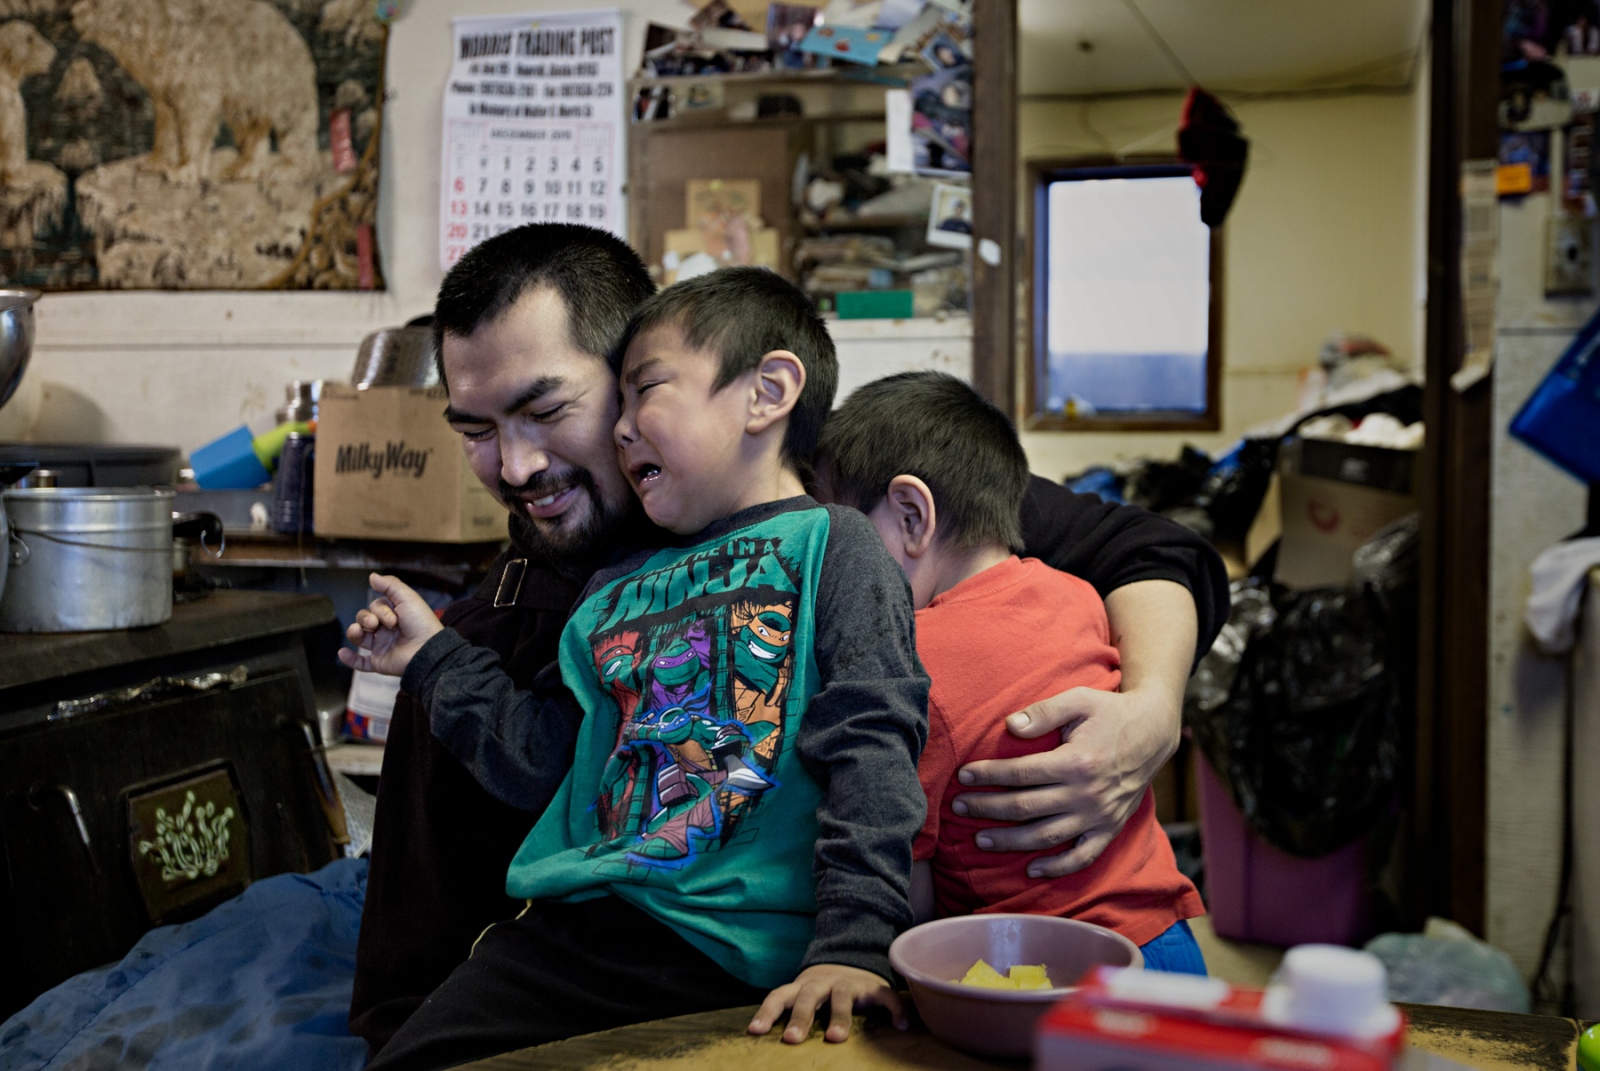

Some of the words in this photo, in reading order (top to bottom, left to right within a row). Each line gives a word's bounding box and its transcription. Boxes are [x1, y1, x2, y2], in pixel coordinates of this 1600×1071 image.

[516, 29, 577, 56] TRADING
[580, 28, 614, 55] POST
[503, 155, 512, 171] 1
[525, 155, 536, 172] 2
[549, 156, 559, 172] 3
[571, 156, 581, 172] 4
[594, 156, 604, 173] 5
[453, 176, 465, 193] 6
[478, 177, 488, 193] 7
[501, 178, 511, 194] 8
[524, 179, 535, 194] 9
[545, 180, 562, 195] 10
[567, 180, 582, 195] 11
[590, 180, 606, 196] 12
[451, 200, 468, 216] 13
[474, 201, 490, 216] 14
[497, 201, 514, 217] 15
[521, 202, 538, 217] 16
[544, 203, 560, 217] 17
[567, 203, 583, 218] 18
[590, 204, 605, 219] 19
[448, 223, 468, 239] 20
[472, 224, 490, 239] 21
[727, 539, 756, 556] I'M
[763, 540, 776, 553] A
[595, 551, 800, 635] NINJA
